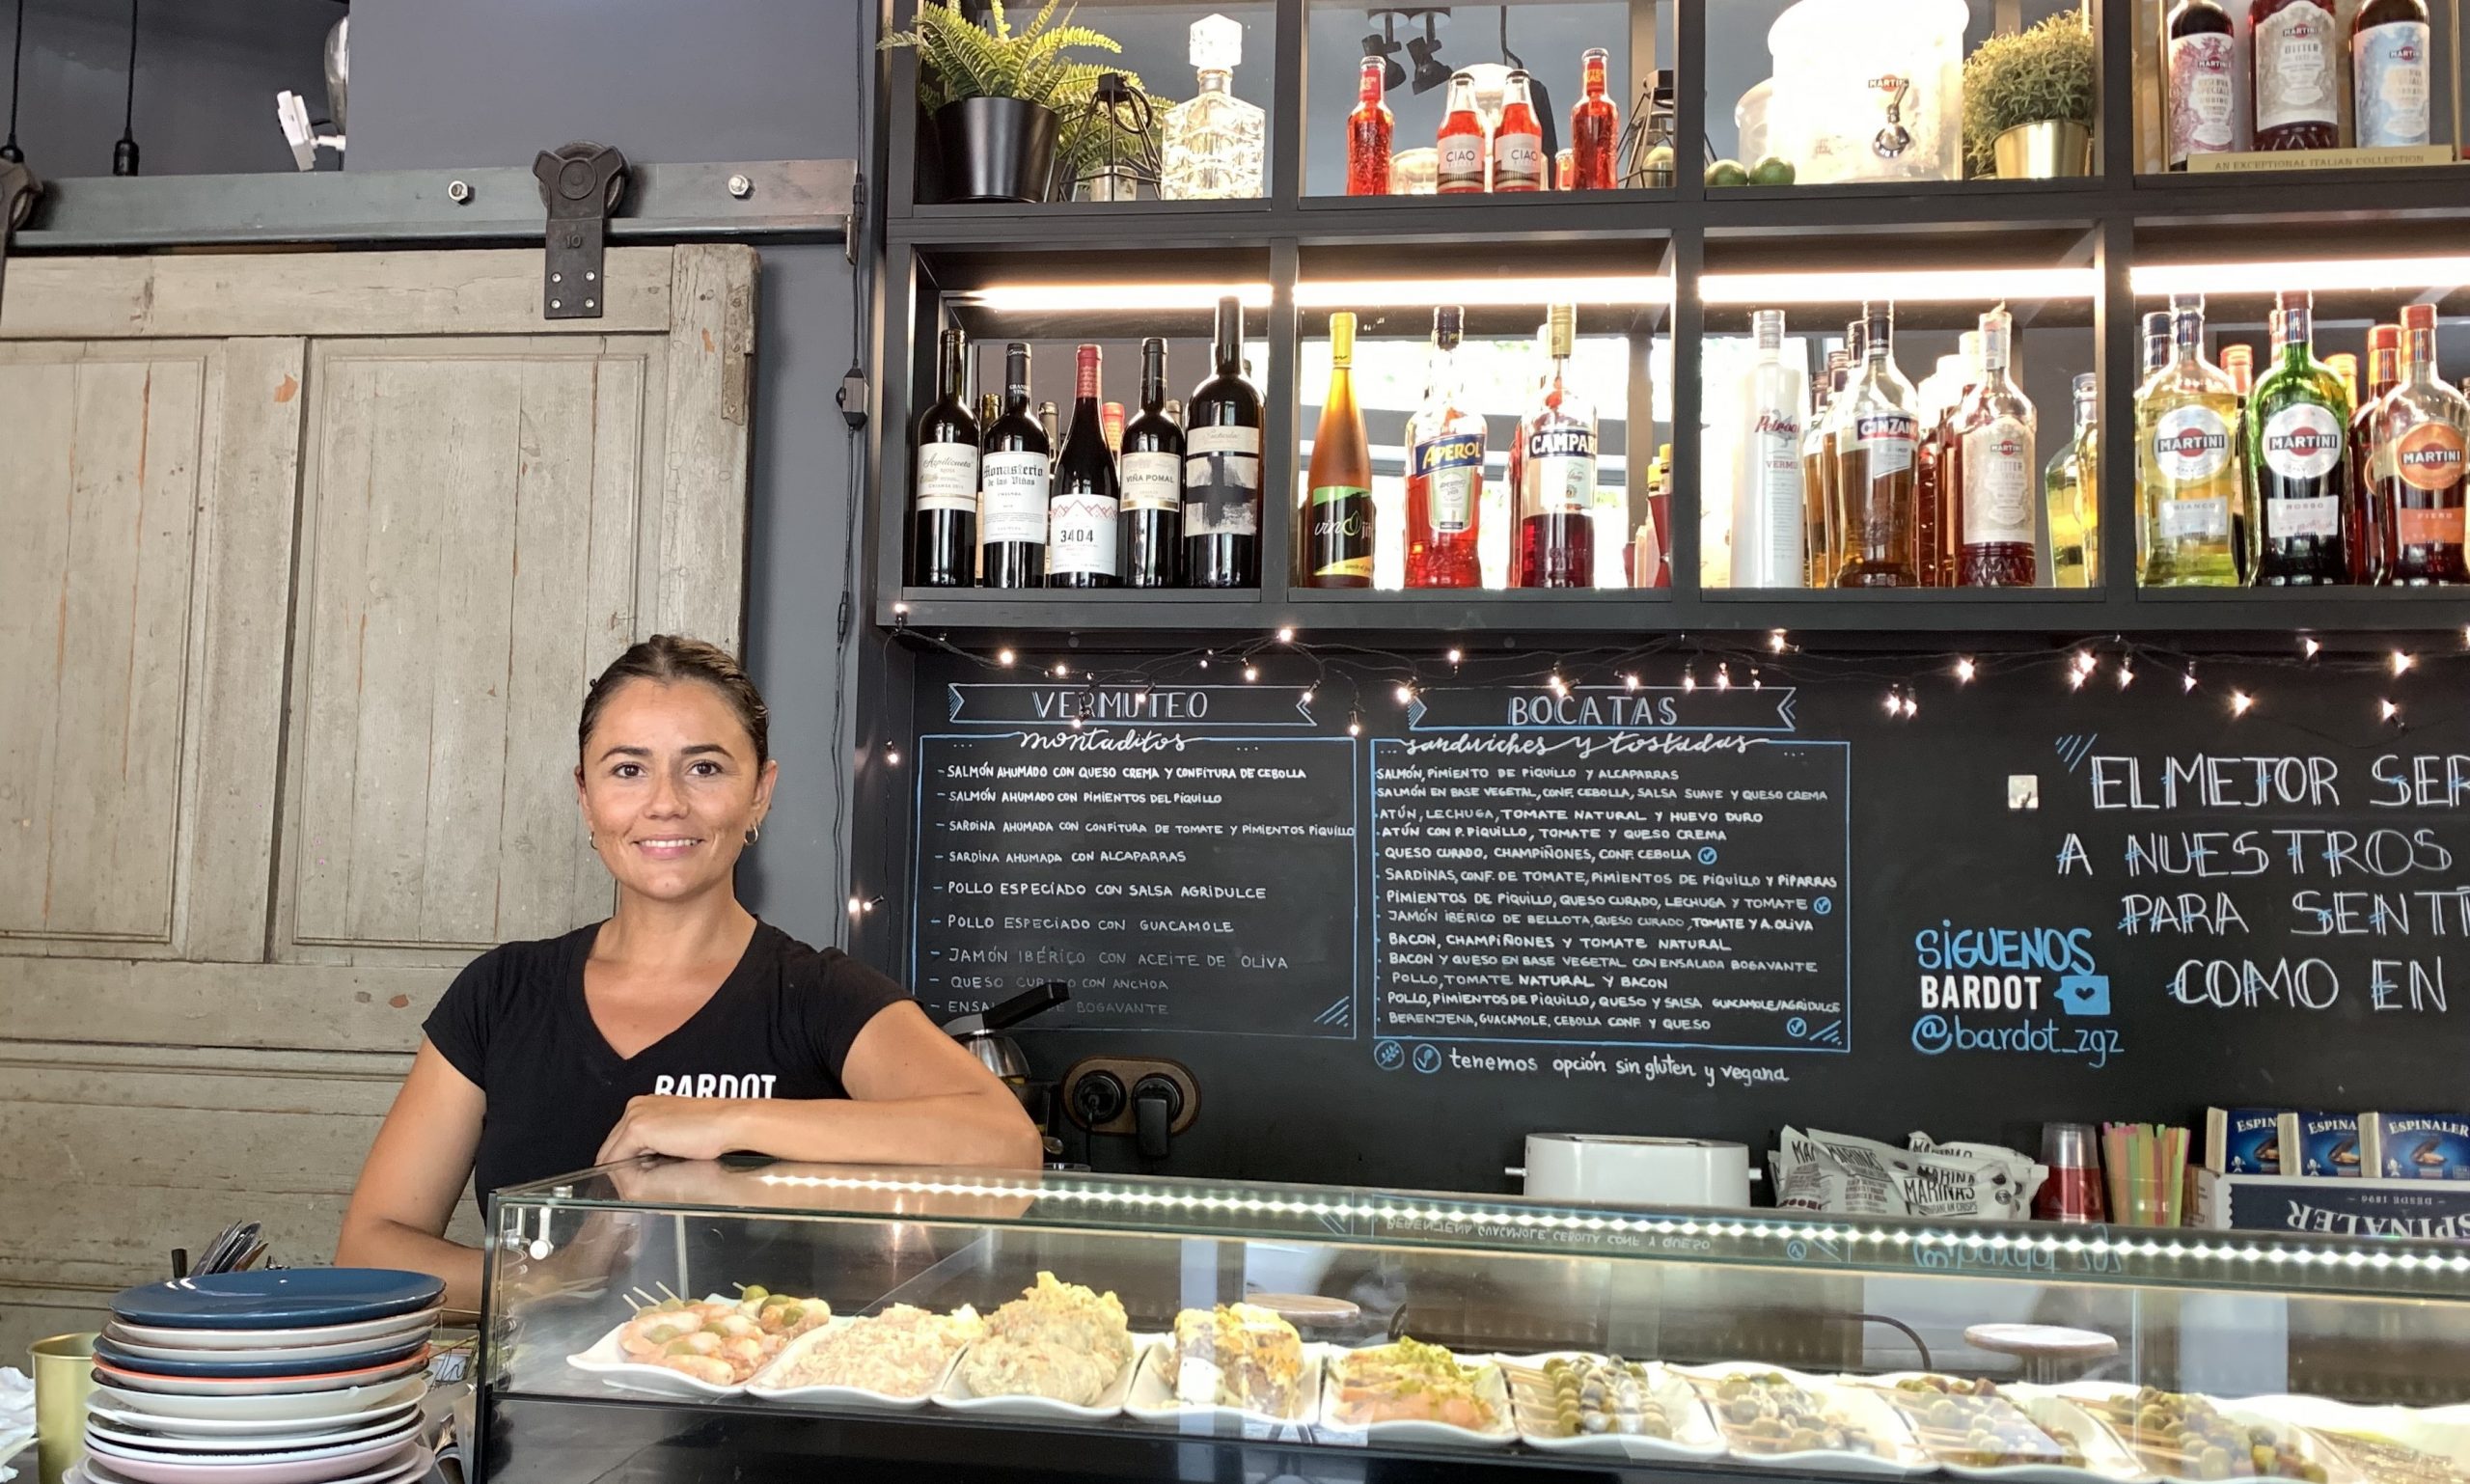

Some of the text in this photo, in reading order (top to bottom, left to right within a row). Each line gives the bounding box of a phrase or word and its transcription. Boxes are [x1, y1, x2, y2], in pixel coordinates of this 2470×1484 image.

[1445, 151, 1475, 163] CIAO
[1511, 149, 1538, 161] CIAO
[2310, 157, 2352, 167] ITALIAN
[1532, 434, 1597, 454] CAMPAR
[2158, 436, 2225, 452] MARTINI
[2269, 436, 2338, 450] MARTINI
[1422, 444, 1482, 469] APEROL
[2402, 450, 2461, 463] MARTINI
[1126, 474, 1174, 483] VIÑA POMAL
[1060, 530, 1094, 543] 3404
[1032, 691, 1209, 719] VERMUTEO
[1507, 696, 1679, 726] BOCATAS
[1020, 728, 1190, 753] montaditos
[947, 762, 1306, 780] SALMÓN AHUMADO CON QUESO CREMA Y DE CEBOLLA
[1497, 769, 1679, 781] DE Y ALCAPARRAS
[949, 787, 1171, 804] SALMÓN AHUMADO CON DEL
[1377, 784, 1827, 800] SALMÓN EN BASE SALSA SUAVE QUESO CREMA
[1500, 810, 1763, 822] TOMATE NATURAL Y HUEVO DURO
[1002, 821, 1222, 836] AHUMADA CON DE TOMATE
[1383, 822, 1727, 840] ATÚN CON TOMATE QUESO CREMA
[1005, 850, 1186, 864] AHUMADA CON ALCAPARRAS
[1386, 847, 1691, 860] QUESO CEBOLLA
[2056, 829, 2453, 877] A NUESTROS
[1498, 871, 1773, 886] DE DE Y
[948, 882, 1172, 897] POLLO CON SALSA
[1474, 893, 1807, 909] DE QUESO LECHUGA TOMATE
[1388, 908, 1438, 921] JAMÓN
[1503, 915, 1521, 923] DE
[1594, 916, 1633, 925] QUESO
[1749, 920, 1757, 929] Y
[2118, 892, 2249, 936] PARA
[948, 916, 1234, 933] POLLO CON GUACAMOLE
[1579, 938, 1732, 950] TOMATE NATURAL
[949, 947, 1225, 966] JAMÓN CON DE
[1389, 952, 1817, 972] BACON Y QUESO EN BASE VEGETAL CON ENSALADA BOGAVANTE
[951, 976, 1168, 990] QUESO CON ANCHOA
[1444, 975, 1667, 988] TOMATE NATURAL BACON
[2167, 956, 2447, 1011] COMO EN
[1921, 976, 2041, 1009] BARDOT
[1077, 1003, 1169, 1014] BOGAVANTE
[1511, 995, 1702, 1008] DE QUESO Y SALSA
[1554, 1017, 1711, 1030] CEBOLLA QUESO
[1911, 1014, 2125, 1068] @bardot_zgz
[1449, 1048, 1790, 1087] tenemos opción sin gluten y vegana
[654, 1074, 777, 1099] BARDOT
[2308, 1119, 2357, 1134] ESPINA
[2389, 1120, 2469, 1137] ESPINALER
